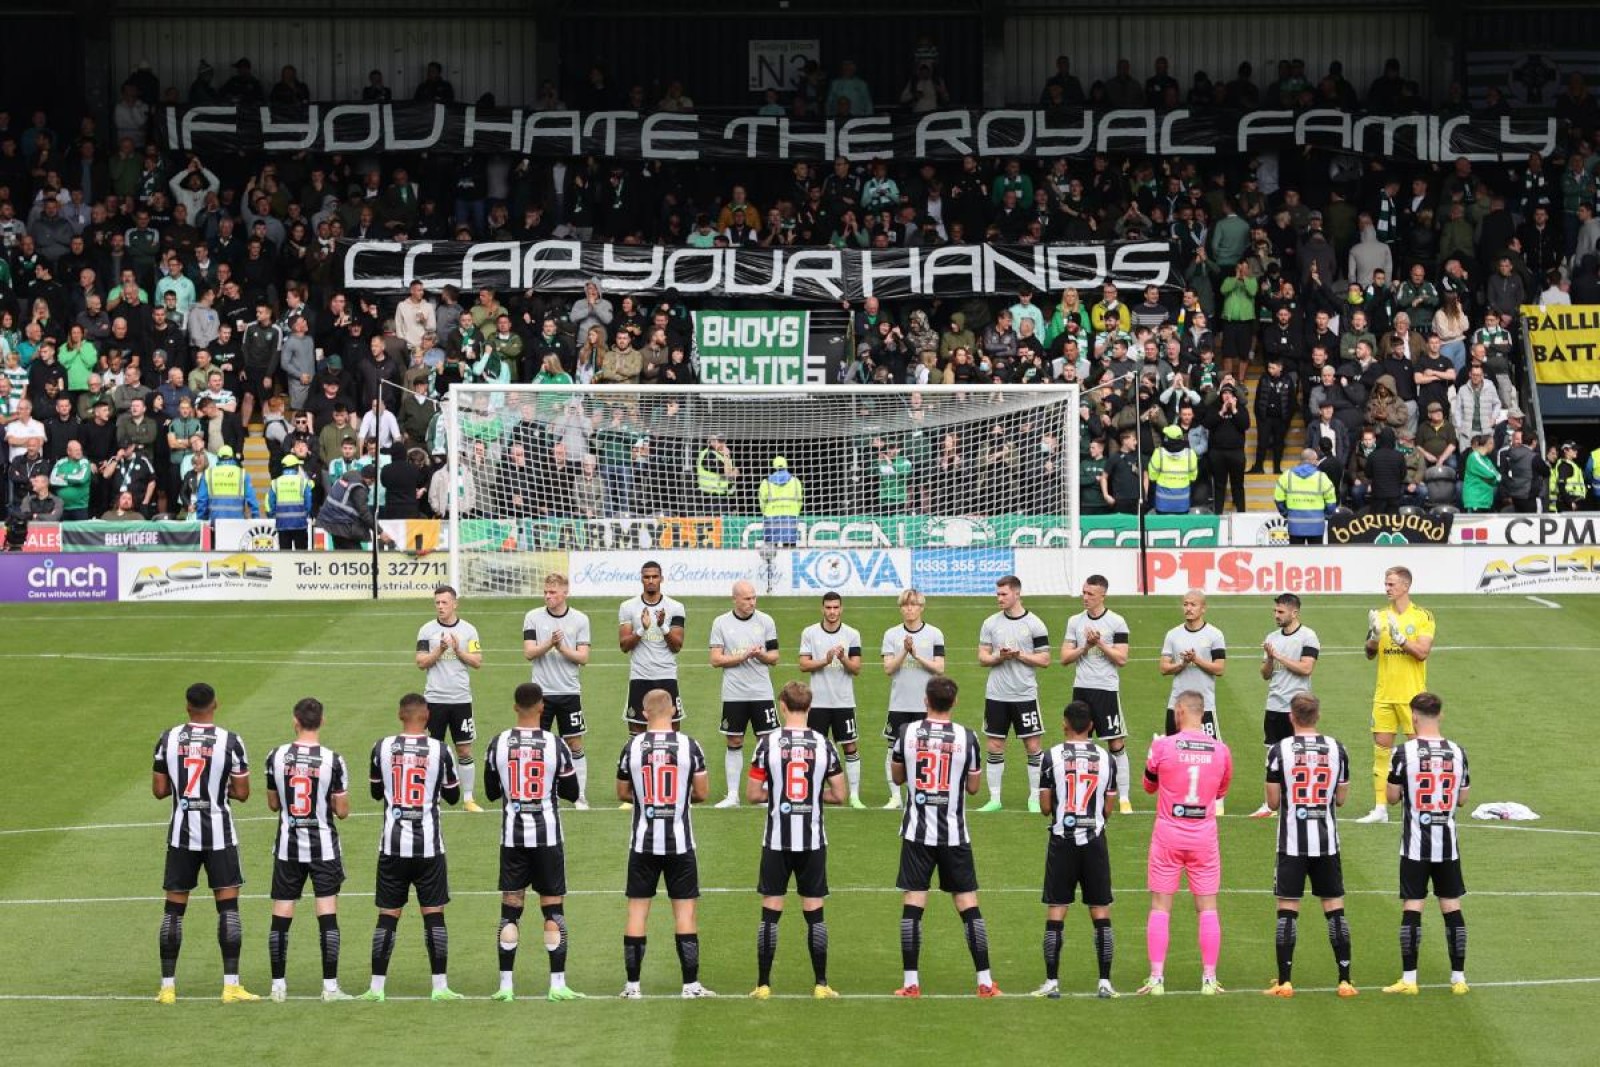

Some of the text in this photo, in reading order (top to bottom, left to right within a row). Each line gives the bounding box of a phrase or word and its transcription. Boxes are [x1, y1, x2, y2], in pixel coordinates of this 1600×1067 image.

[165, 105, 237, 151] IF
[259, 103, 446, 152] YOU
[463, 106, 701, 161] HATE
[723, 114, 895, 161] THE
[602, 242, 846, 299] YOUR
[862, 241, 1171, 298] HANDS
[702, 315, 800, 348] BHOYS
[699, 355, 801, 385] CELTIC
[1532, 343, 1600, 362] BATT
[23, 533, 62, 547] ALES
[27, 558, 108, 588] cinch
[129, 558, 273, 596] ACRE
[294, 562, 322, 576] Tel:
[387, 562, 448, 576] 327711
[27, 590, 47, 599] Cars
[48, 589, 77, 598] without
[78, 589, 91, 598] the
[1021, 711, 1039, 728] 56
[183, 757, 206, 798] 7
[391, 765, 426, 806] 16
[507, 760, 545, 800] 18
[641, 764, 678, 805] 10
[786, 761, 809, 801] 6
[915, 750, 950, 792] 31
[1185, 765, 1200, 804] 1
[1291, 766, 1331, 805] 22
[289, 775, 313, 816] 3
[1065, 772, 1100, 813] 17
[1415, 771, 1456, 812] 23
